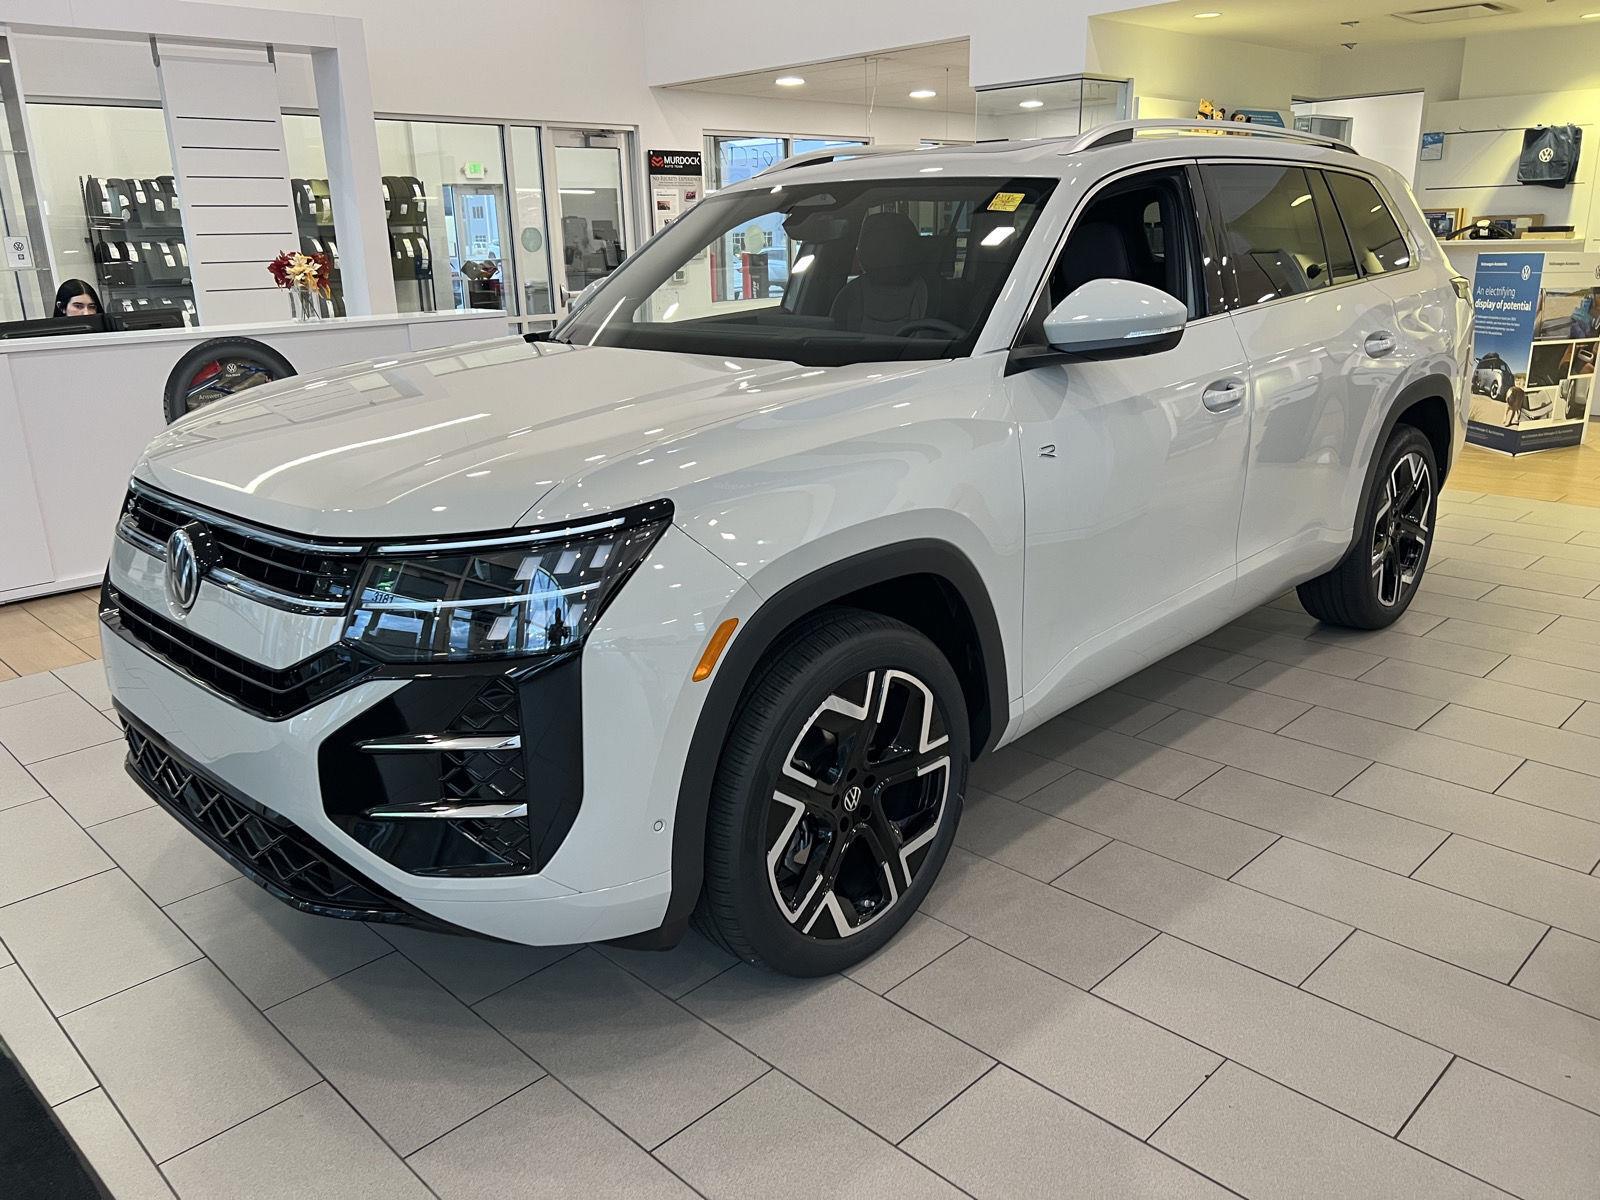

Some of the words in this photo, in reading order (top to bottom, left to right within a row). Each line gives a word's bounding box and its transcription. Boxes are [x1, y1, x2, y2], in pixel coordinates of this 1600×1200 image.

[664, 156, 700, 165] MURDOCK
[1476, 286, 1484, 295] An
[1485, 286, 1516, 298] electrifying
[1475, 299, 1496, 311] display
[1496, 301, 1503, 309] of
[1503, 301, 1532, 311] potential
